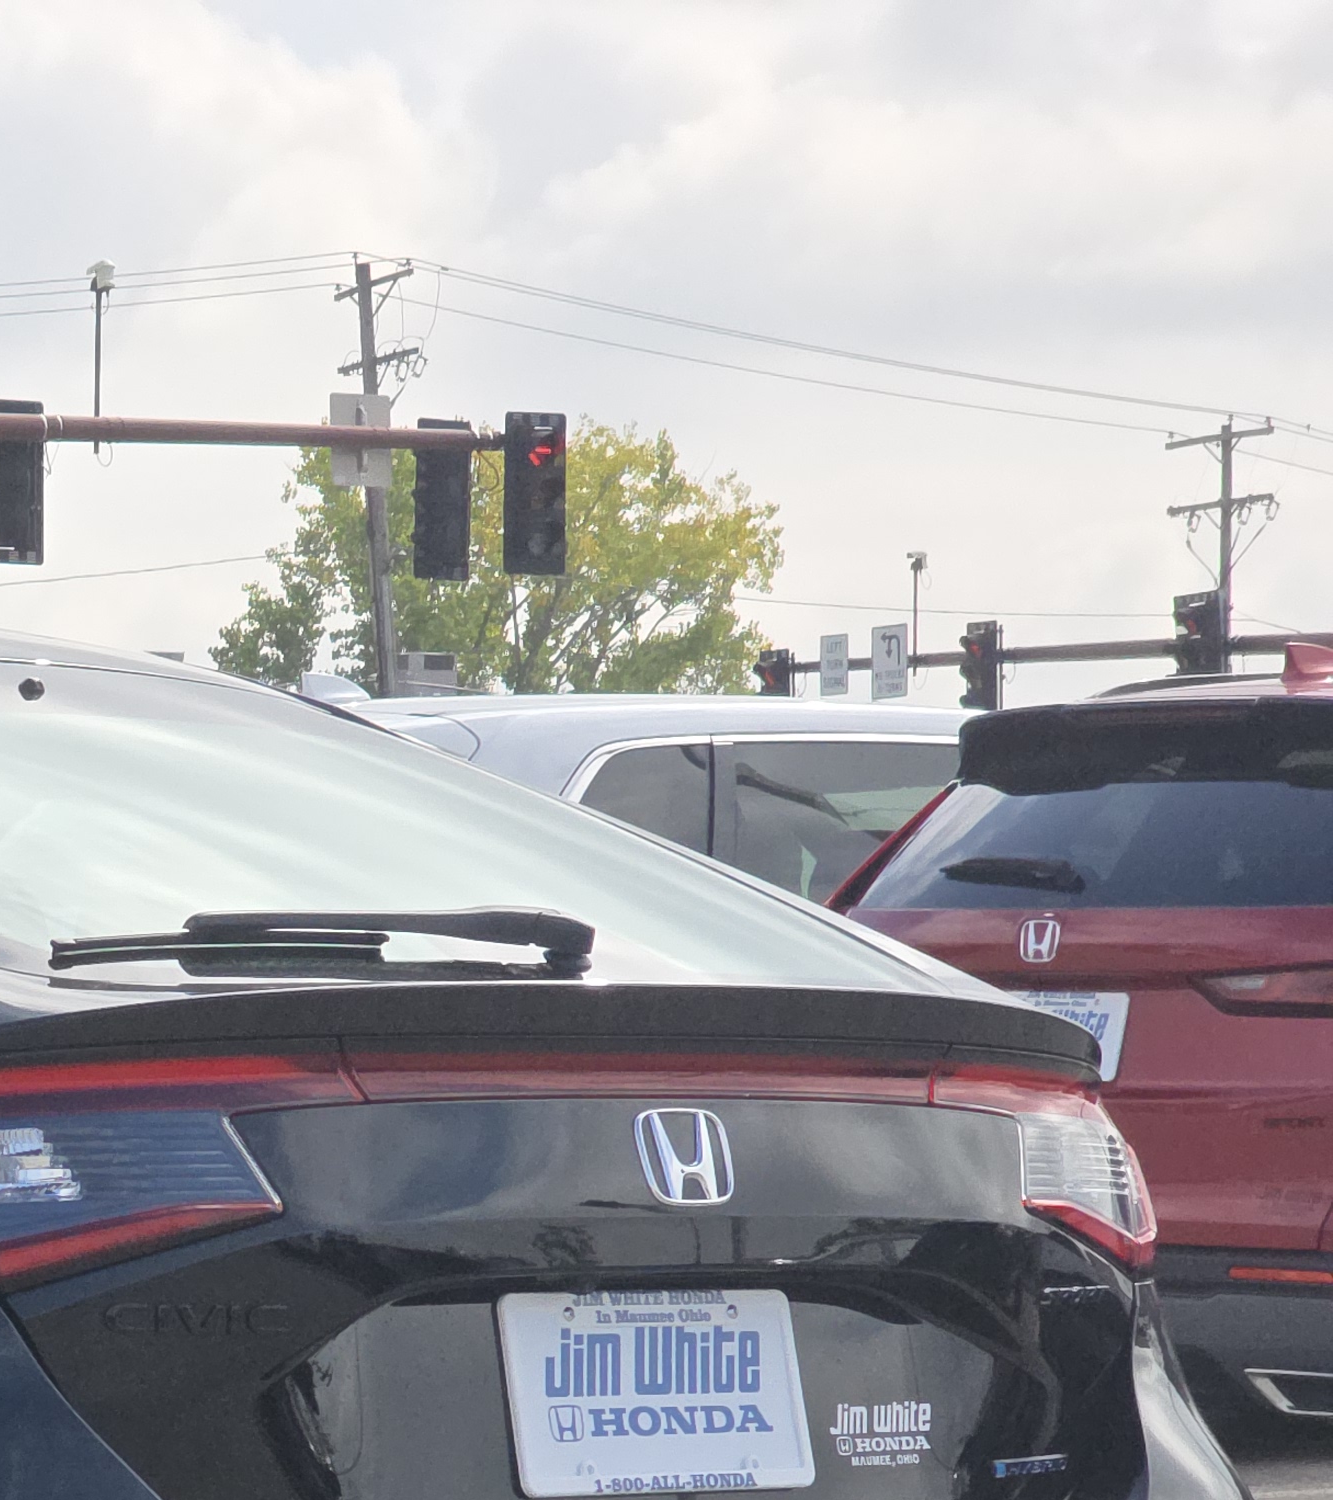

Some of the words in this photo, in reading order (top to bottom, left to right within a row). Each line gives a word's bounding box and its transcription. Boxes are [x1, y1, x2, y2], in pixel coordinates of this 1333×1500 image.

[572, 1292, 605, 1307] JIM
[609, 1289, 664, 1306] WHITE
[667, 1289, 727, 1306] HONDA
[103, 1302, 288, 1334] CIVIC
[595, 1310, 612, 1324] In
[677, 1308, 712, 1323] Ohio
[634, 1325, 761, 1396] White
[588, 1404, 774, 1437] HONDA
[854, 1435, 931, 1453] HONDA
[851, 1454, 896, 1467] MAUMEE,
[896, 1453, 920, 1465] OHIO
[594, 1472, 758, 1494] 1-800-ALL-HONDA
